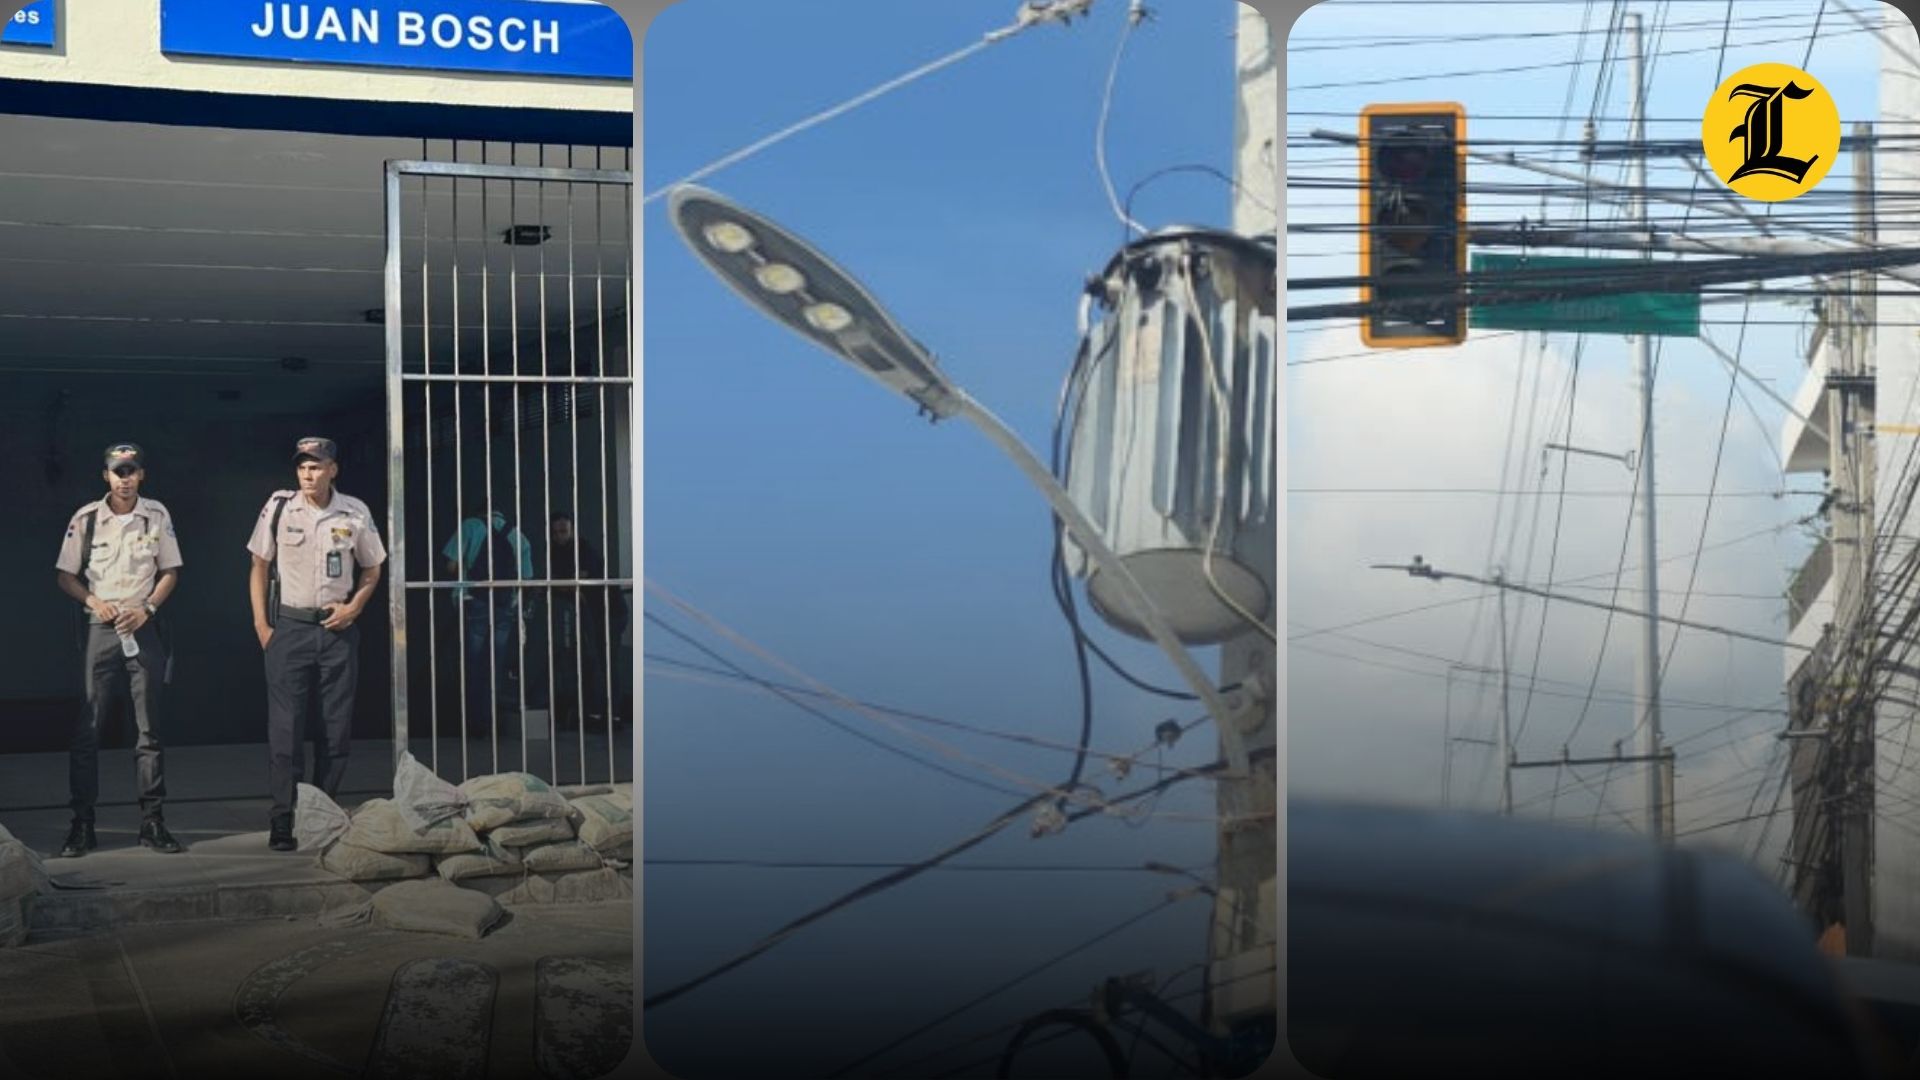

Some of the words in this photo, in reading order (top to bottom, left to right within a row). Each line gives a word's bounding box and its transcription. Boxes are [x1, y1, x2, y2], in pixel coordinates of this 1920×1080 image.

[10, 10, 40, 24] es
[251, 2, 379, 44] JUAN
[398, 11, 559, 54] BOSCH
